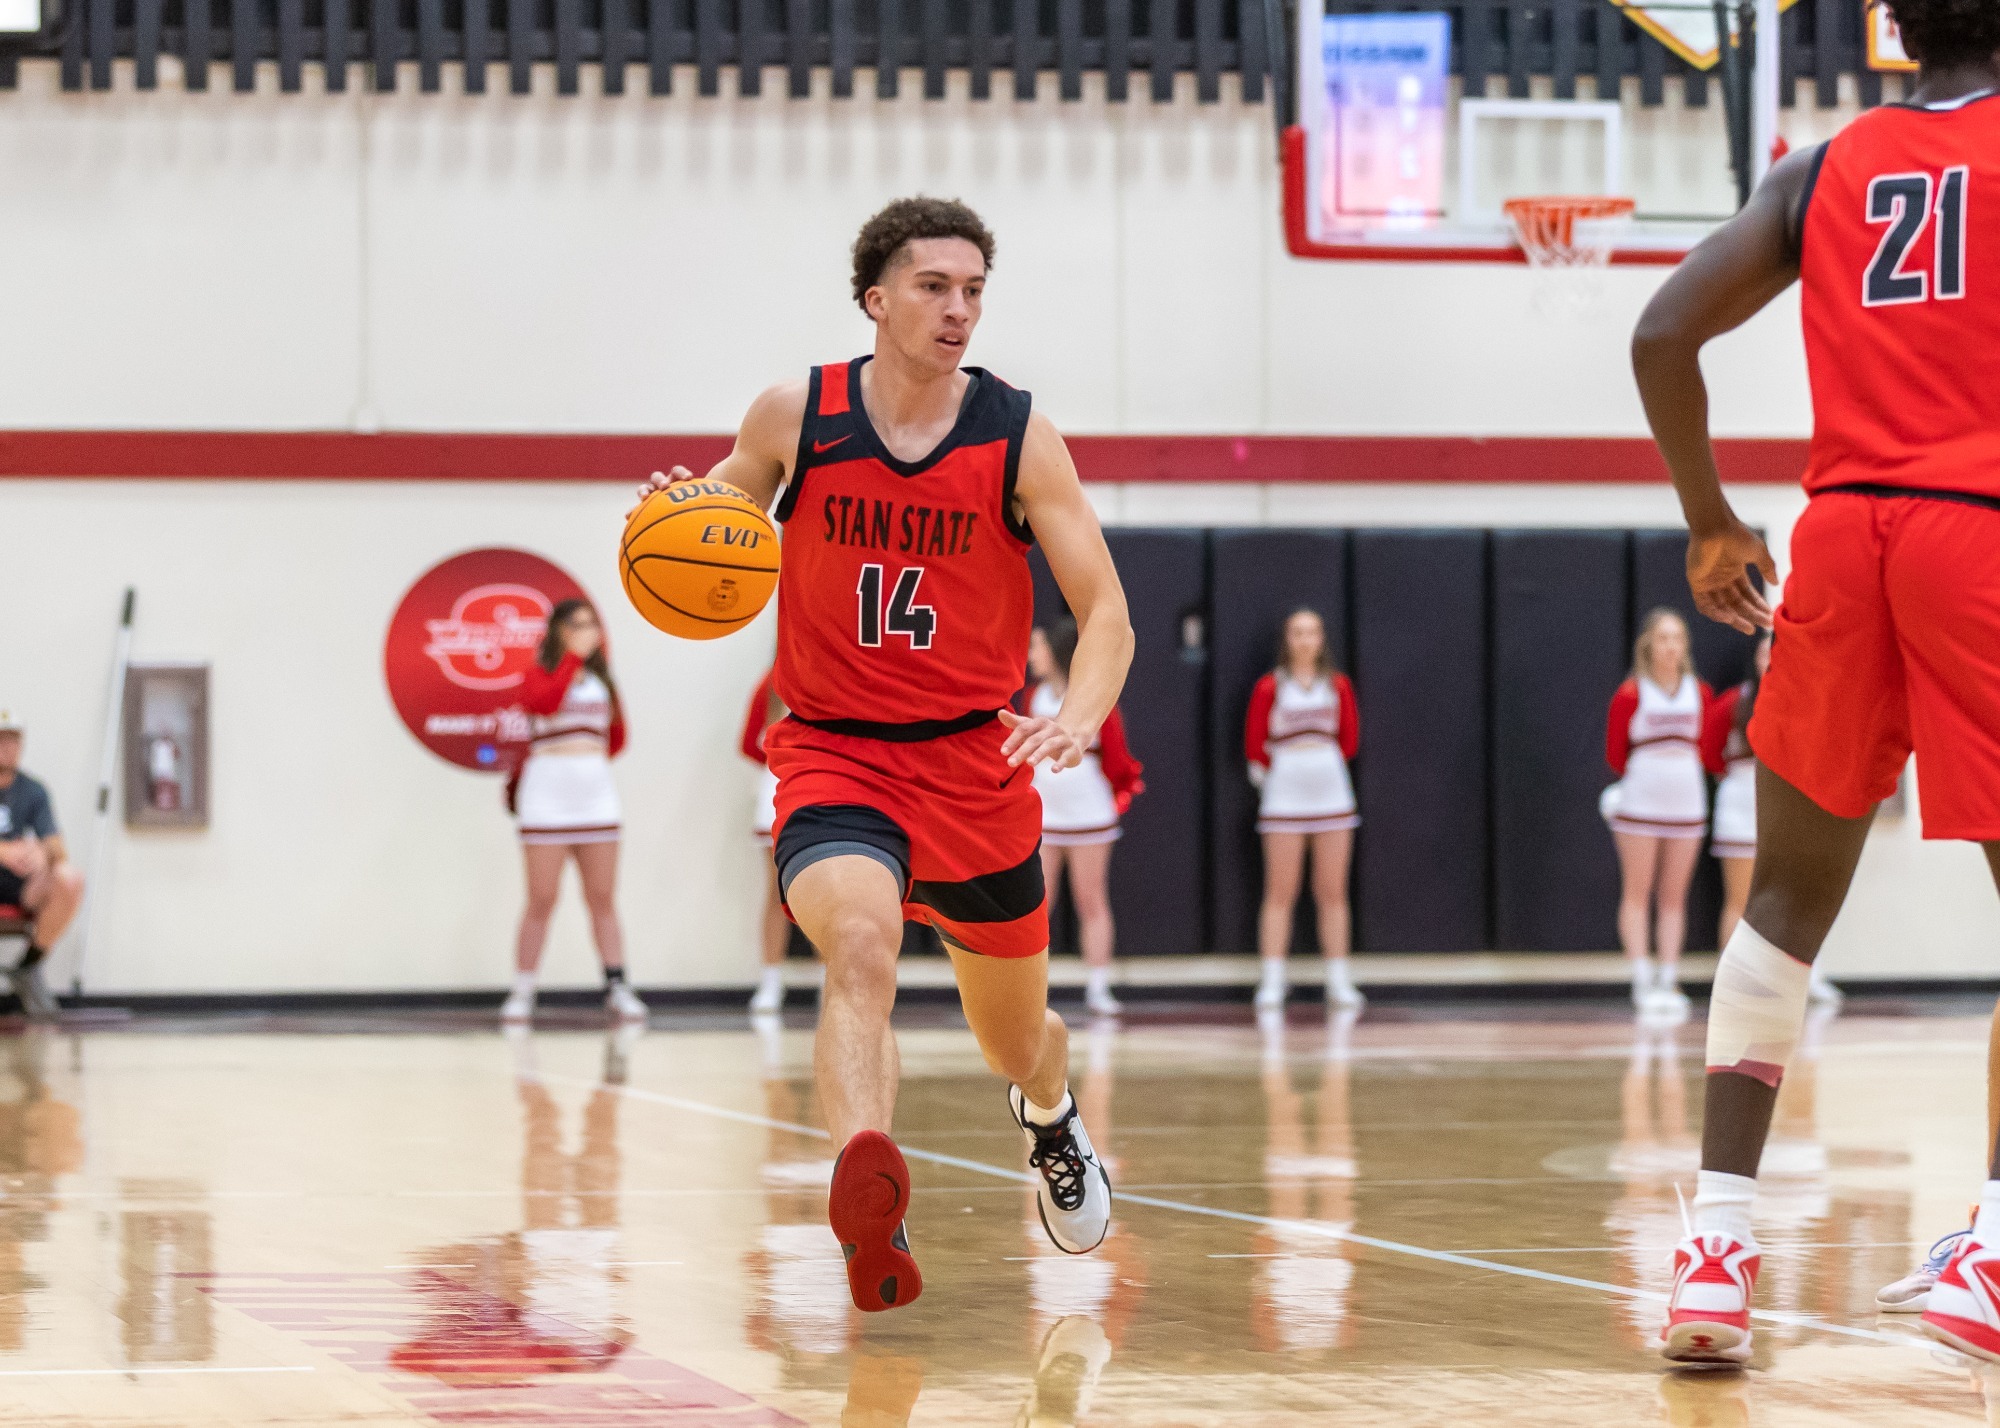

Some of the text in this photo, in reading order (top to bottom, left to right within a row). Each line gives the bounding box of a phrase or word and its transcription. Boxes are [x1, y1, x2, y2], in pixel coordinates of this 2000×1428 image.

[1861, 164, 1970, 309] 21
[665, 482, 759, 507] Wilso
[823, 493, 979, 557] STAN STATE
[701, 525, 760, 549] EVO
[855, 562, 938, 650] 14
